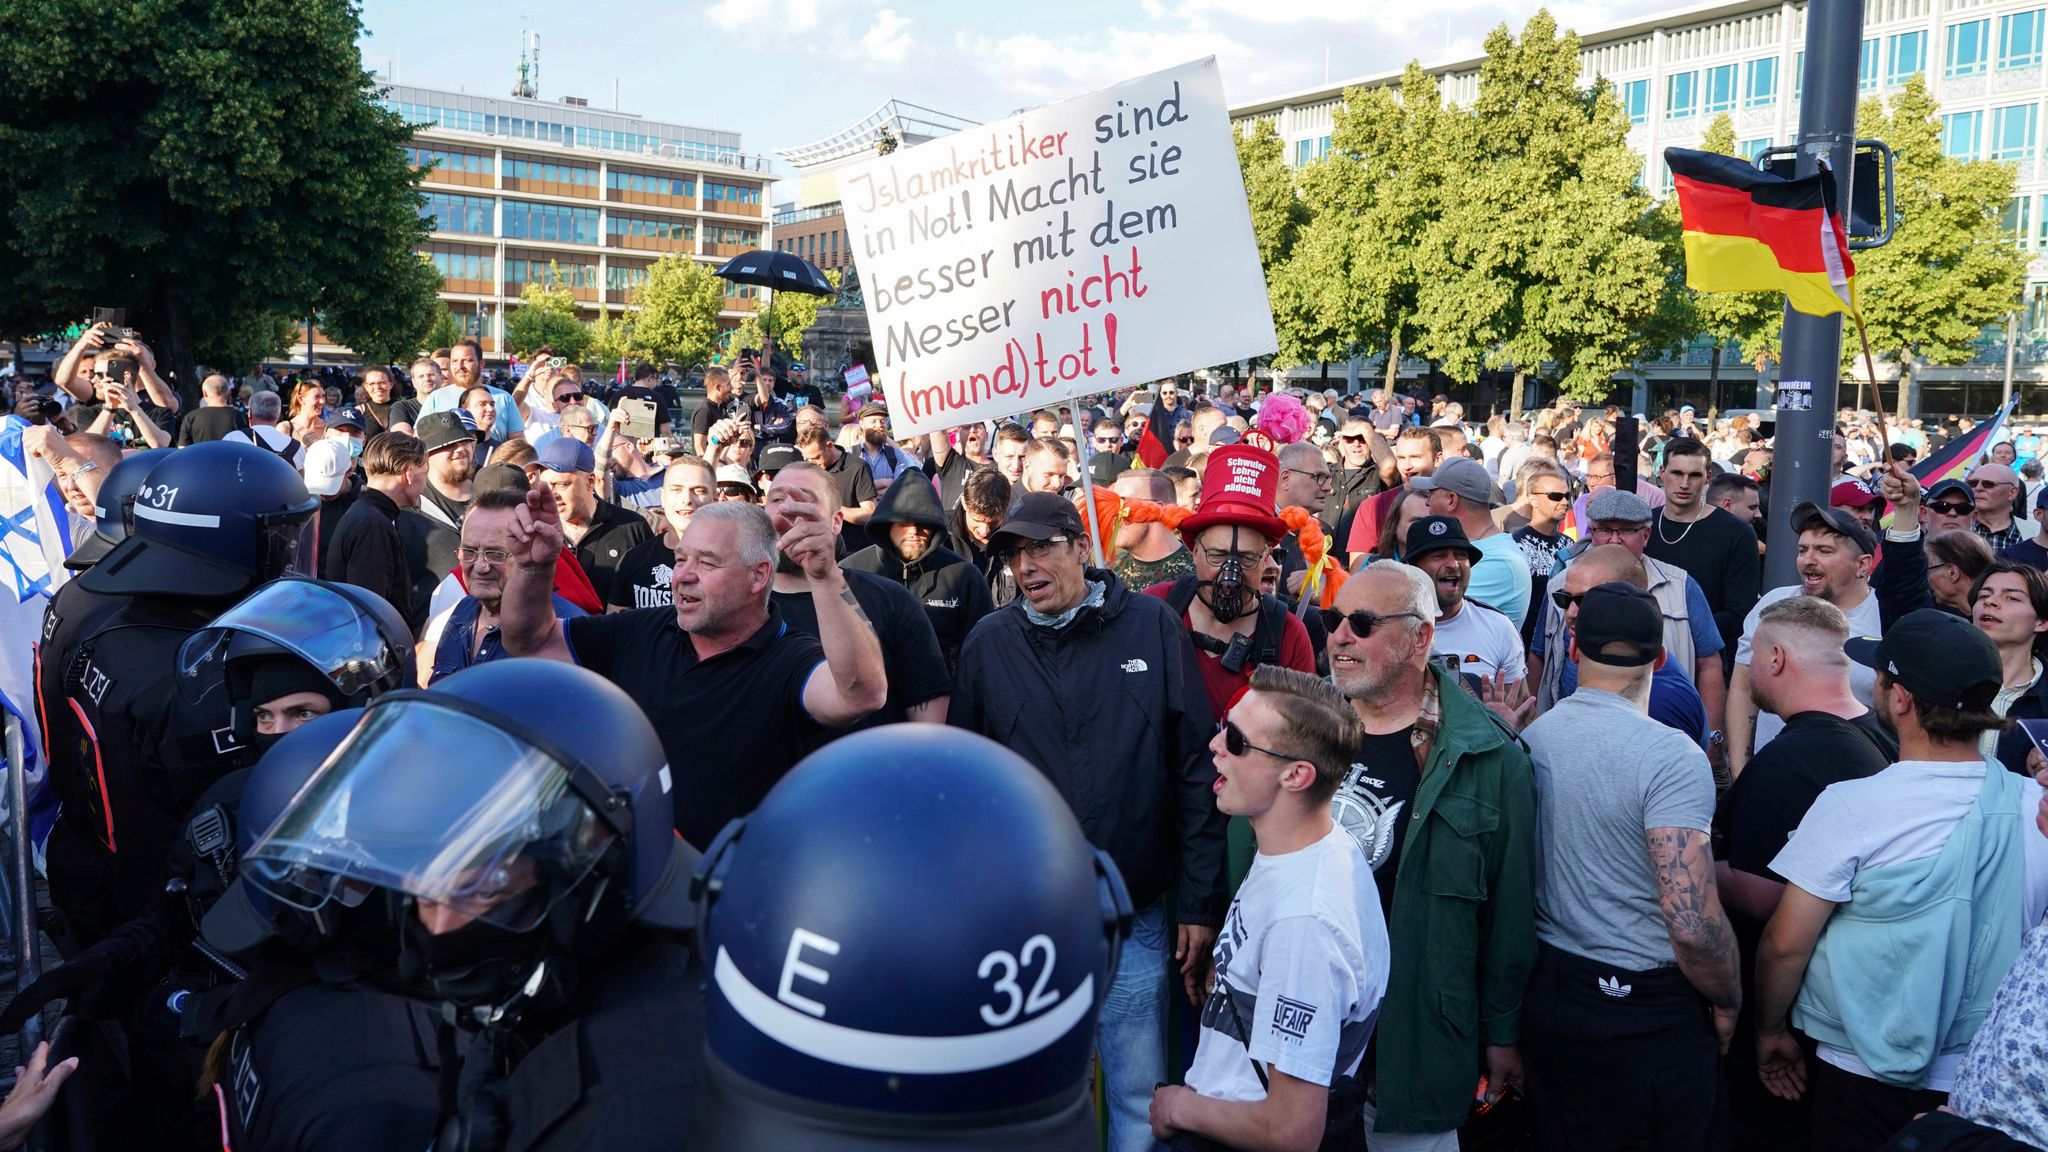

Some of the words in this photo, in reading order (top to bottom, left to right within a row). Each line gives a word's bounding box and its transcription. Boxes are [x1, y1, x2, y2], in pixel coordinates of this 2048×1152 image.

[1095, 80, 1189, 144] sind
[863, 224, 896, 259] in
[908, 190, 973, 245] Not!
[988, 150, 1106, 222] Macht
[1128, 140, 1182, 184] sie
[871, 249, 995, 313] besser
[1013, 210, 1076, 269] mit
[1090, 199, 1178, 248] dem
[885, 298, 1016, 368] Messer
[1041, 246, 1148, 320] nicht
[1227, 457, 1267, 472] Schwuler
[1232, 466, 1260, 478] Lehrer
[1233, 475, 1257, 486] nicht
[151, 484, 179, 511] 31
[1224, 482, 1262, 498] pädophil
[776, 926, 841, 1019] E
[976, 933, 1061, 1028] 32
